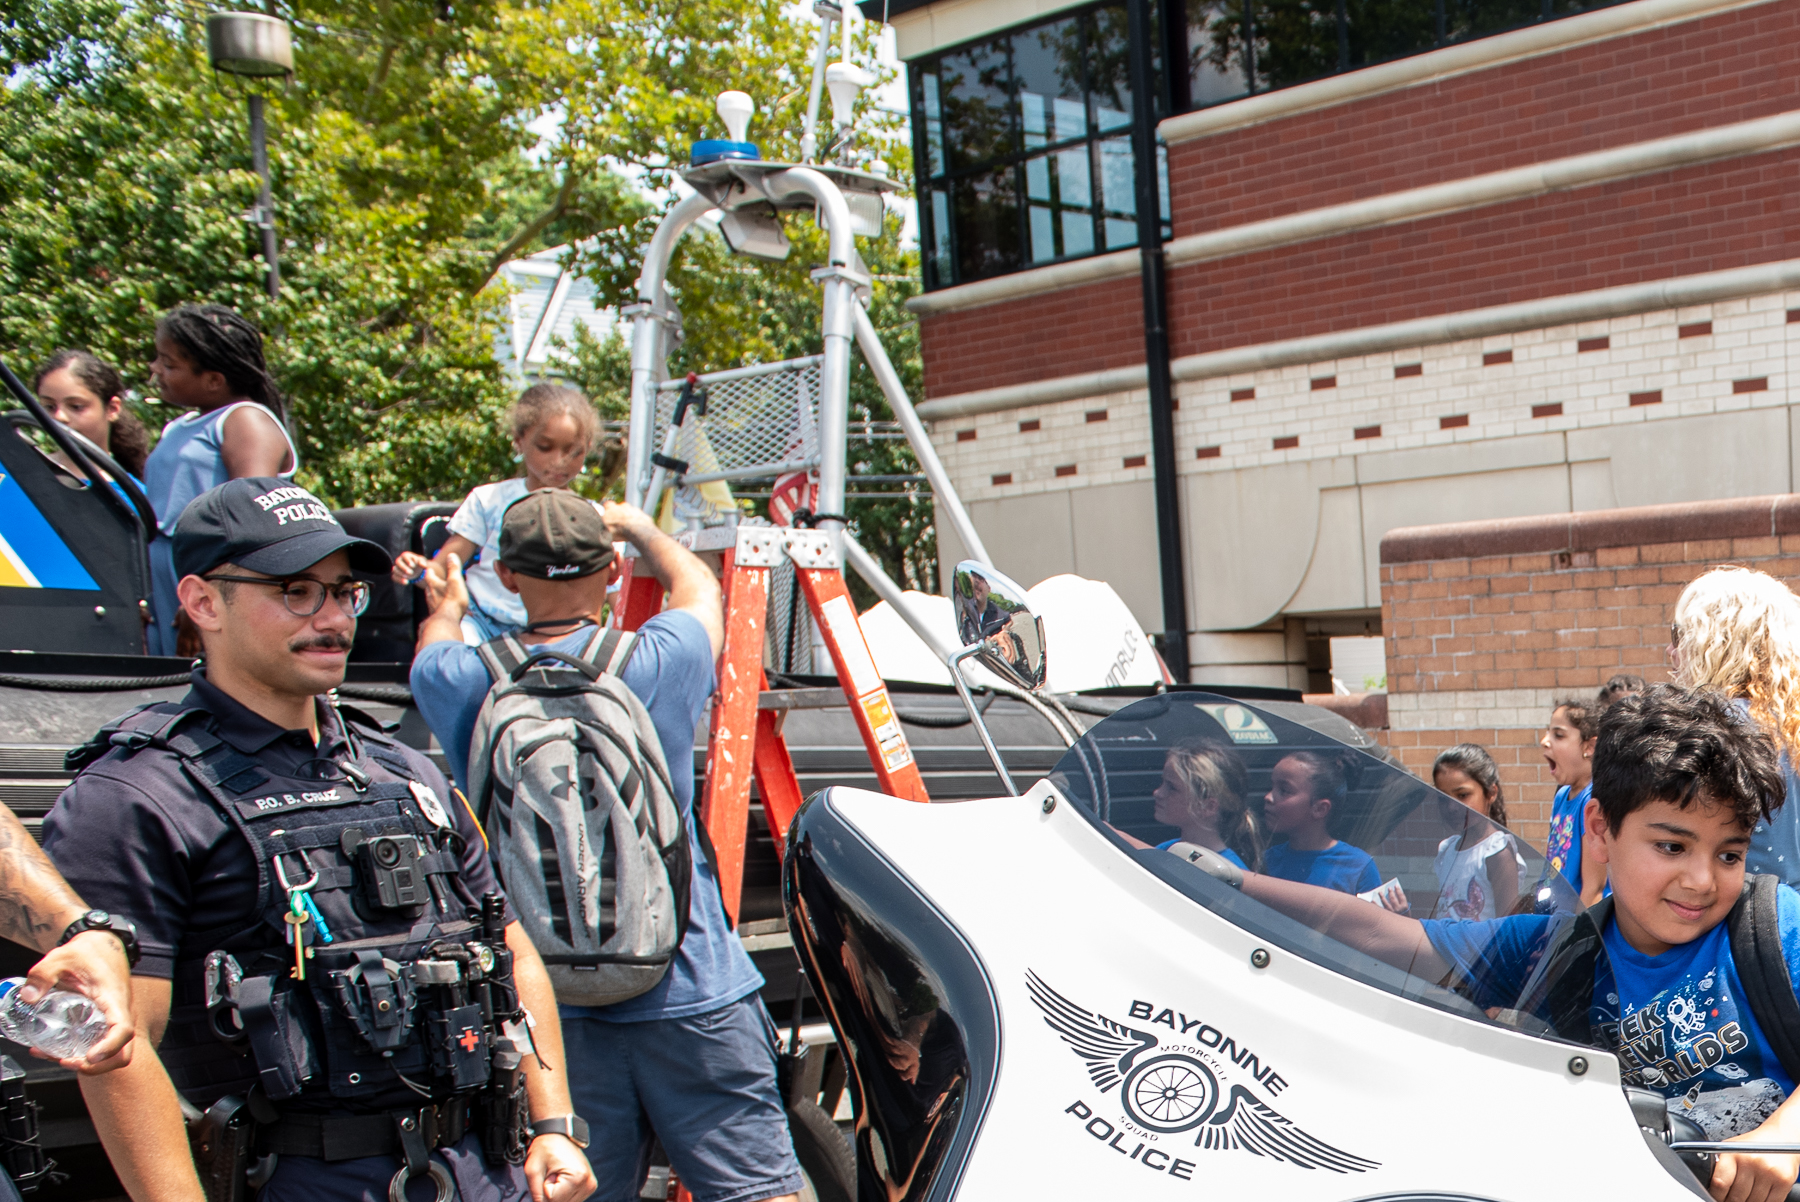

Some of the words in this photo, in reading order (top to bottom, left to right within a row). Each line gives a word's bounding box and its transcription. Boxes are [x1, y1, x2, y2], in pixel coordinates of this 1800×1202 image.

[283, 794, 301, 805] B.
[302, 789, 341, 803] CRUZ
[577, 823, 585, 872] UNDER
[1128, 999, 1289, 1097] BAYONNE
[1160, 1045, 1228, 1081] MOTORCYCLE
[1065, 1099, 1197, 1181] POLICE
[1119, 1116, 1158, 1141] SQUAD
